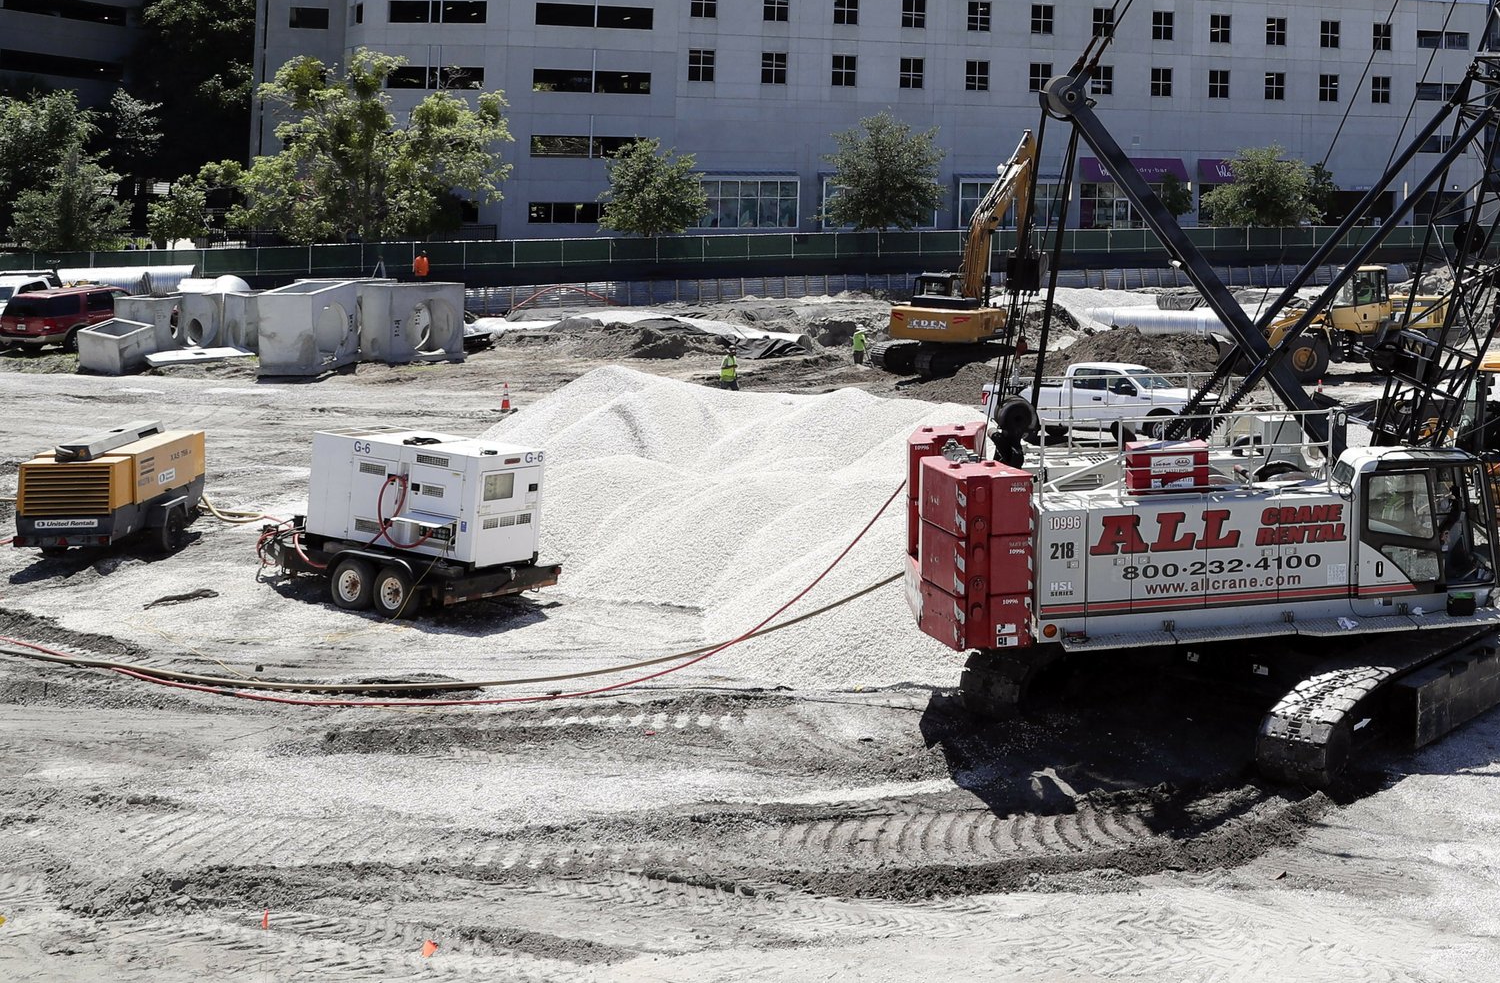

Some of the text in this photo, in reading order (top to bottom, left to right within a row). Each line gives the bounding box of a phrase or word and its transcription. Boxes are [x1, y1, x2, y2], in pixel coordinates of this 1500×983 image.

[354, 441, 371, 454] G-6
[524, 451, 544, 463] G-6
[1048, 516, 1082, 531] 10996
[1260, 503, 1344, 526] CRANE
[1089, 509, 1242, 556] ALL
[1255, 523, 1347, 546] RENTAL
[1050, 542, 1075, 560] 218
[1050, 581, 1073, 591] HSL
[1145, 574, 1302, 595] www.allcrane.com
